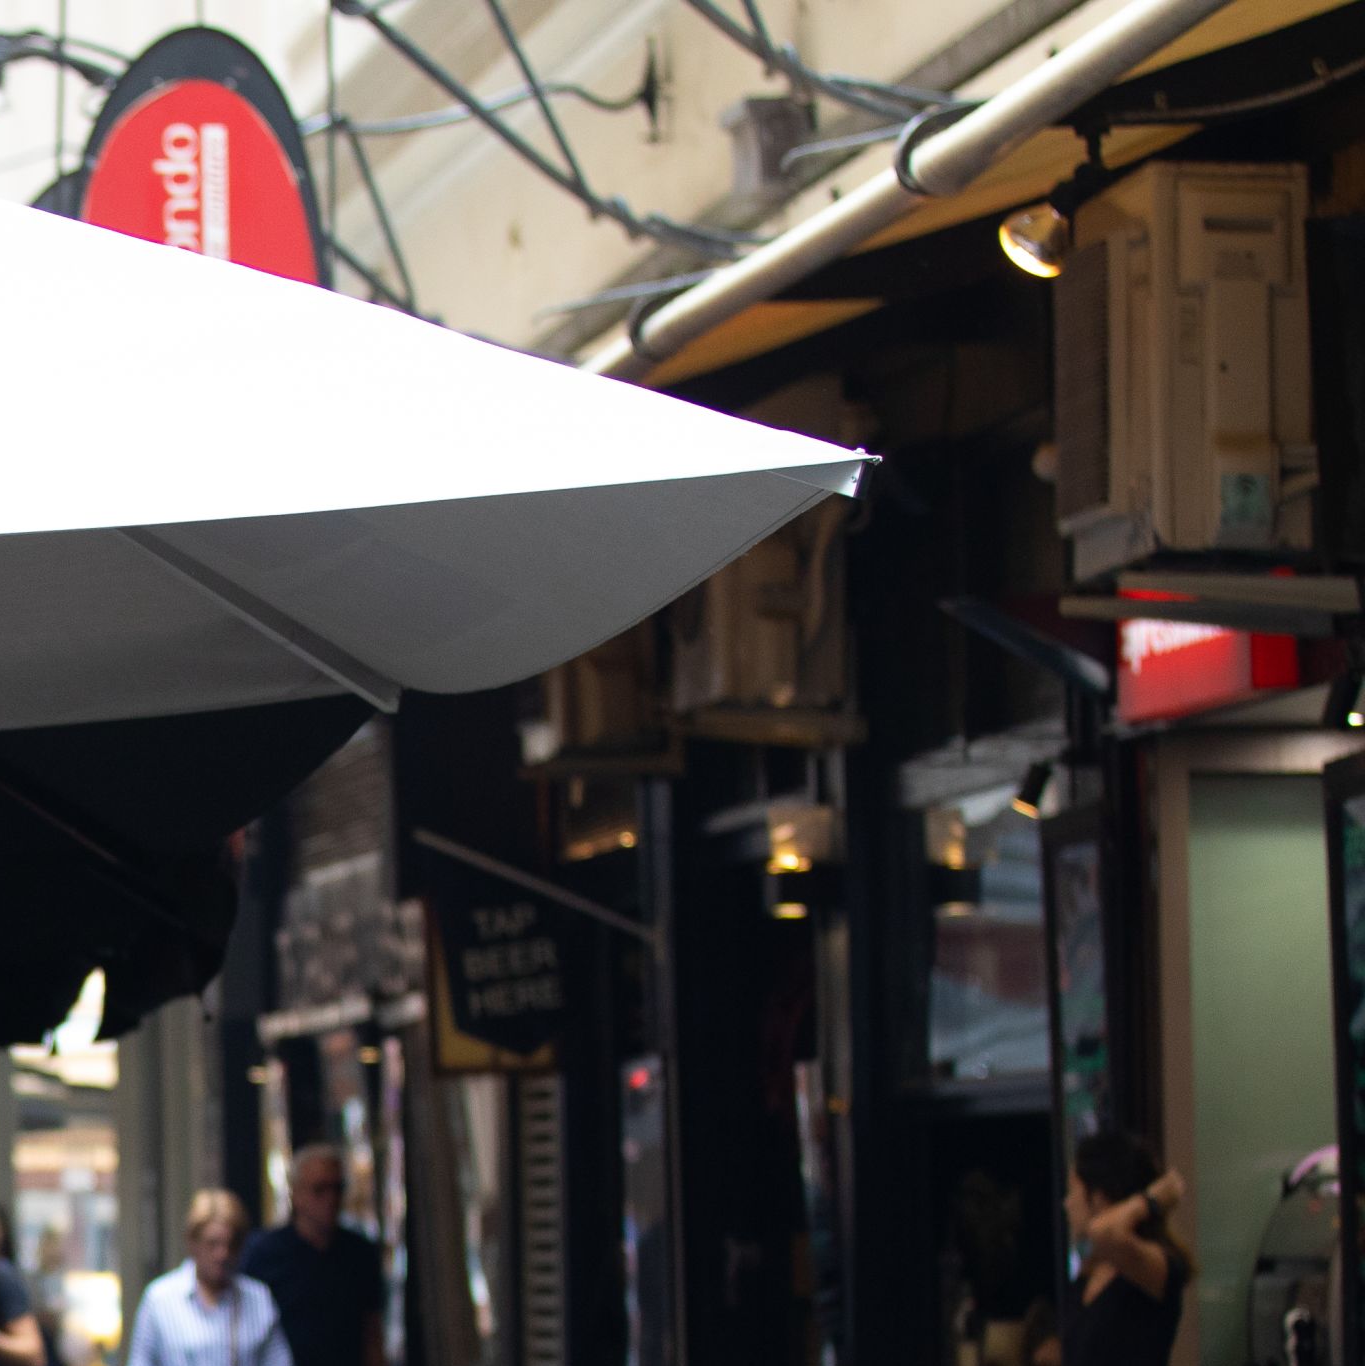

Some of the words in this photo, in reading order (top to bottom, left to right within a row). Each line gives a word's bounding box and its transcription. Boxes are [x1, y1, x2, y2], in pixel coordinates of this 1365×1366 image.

[471, 901, 538, 941] TAP
[462, 936, 558, 982] BEER
[467, 975, 565, 1019] HERE
